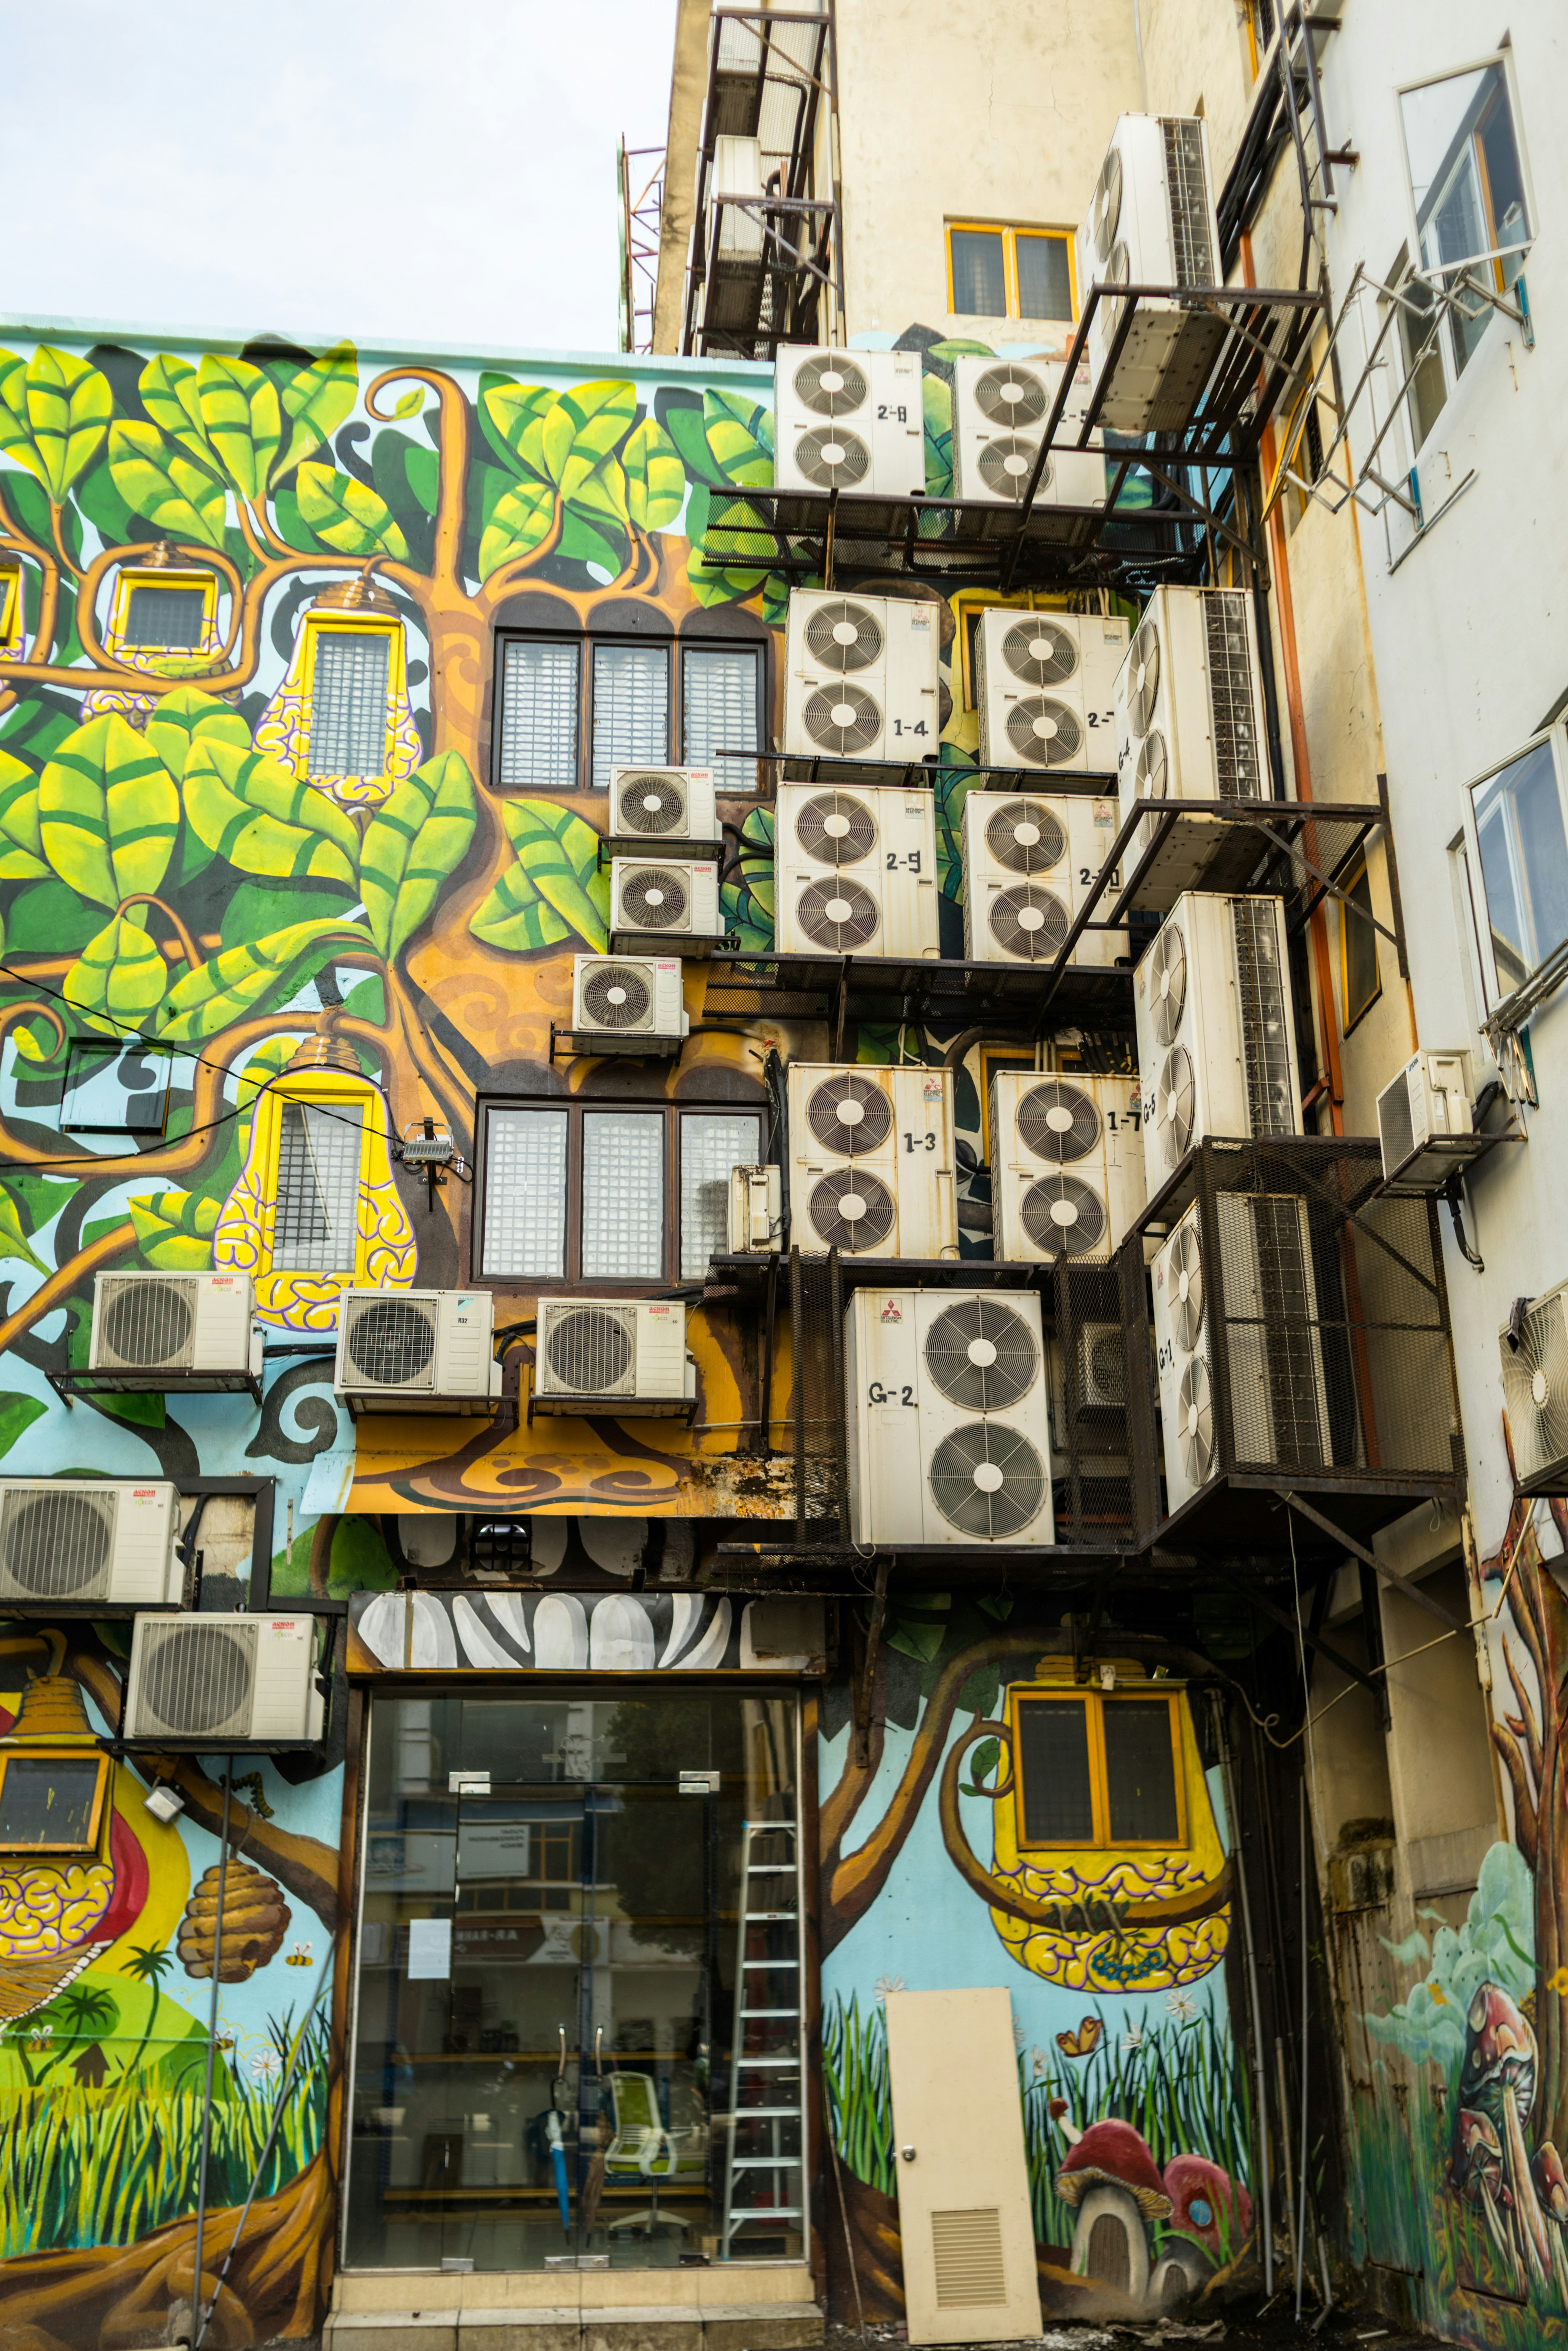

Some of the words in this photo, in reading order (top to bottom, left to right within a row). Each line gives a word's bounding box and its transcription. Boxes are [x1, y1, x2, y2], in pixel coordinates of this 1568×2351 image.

[894, 719, 928, 736] 1-4
[887, 851, 921, 874] 2-9
[1080, 868, 1119, 887] 2-0
[1144, 1092, 1155, 1124] G-5
[1107, 1112, 1141, 1131] 1-7
[904, 1133, 936, 1153] 1-3
[1159, 1338, 1172, 1370] G-1
[869, 1382, 914, 1407] G-2
